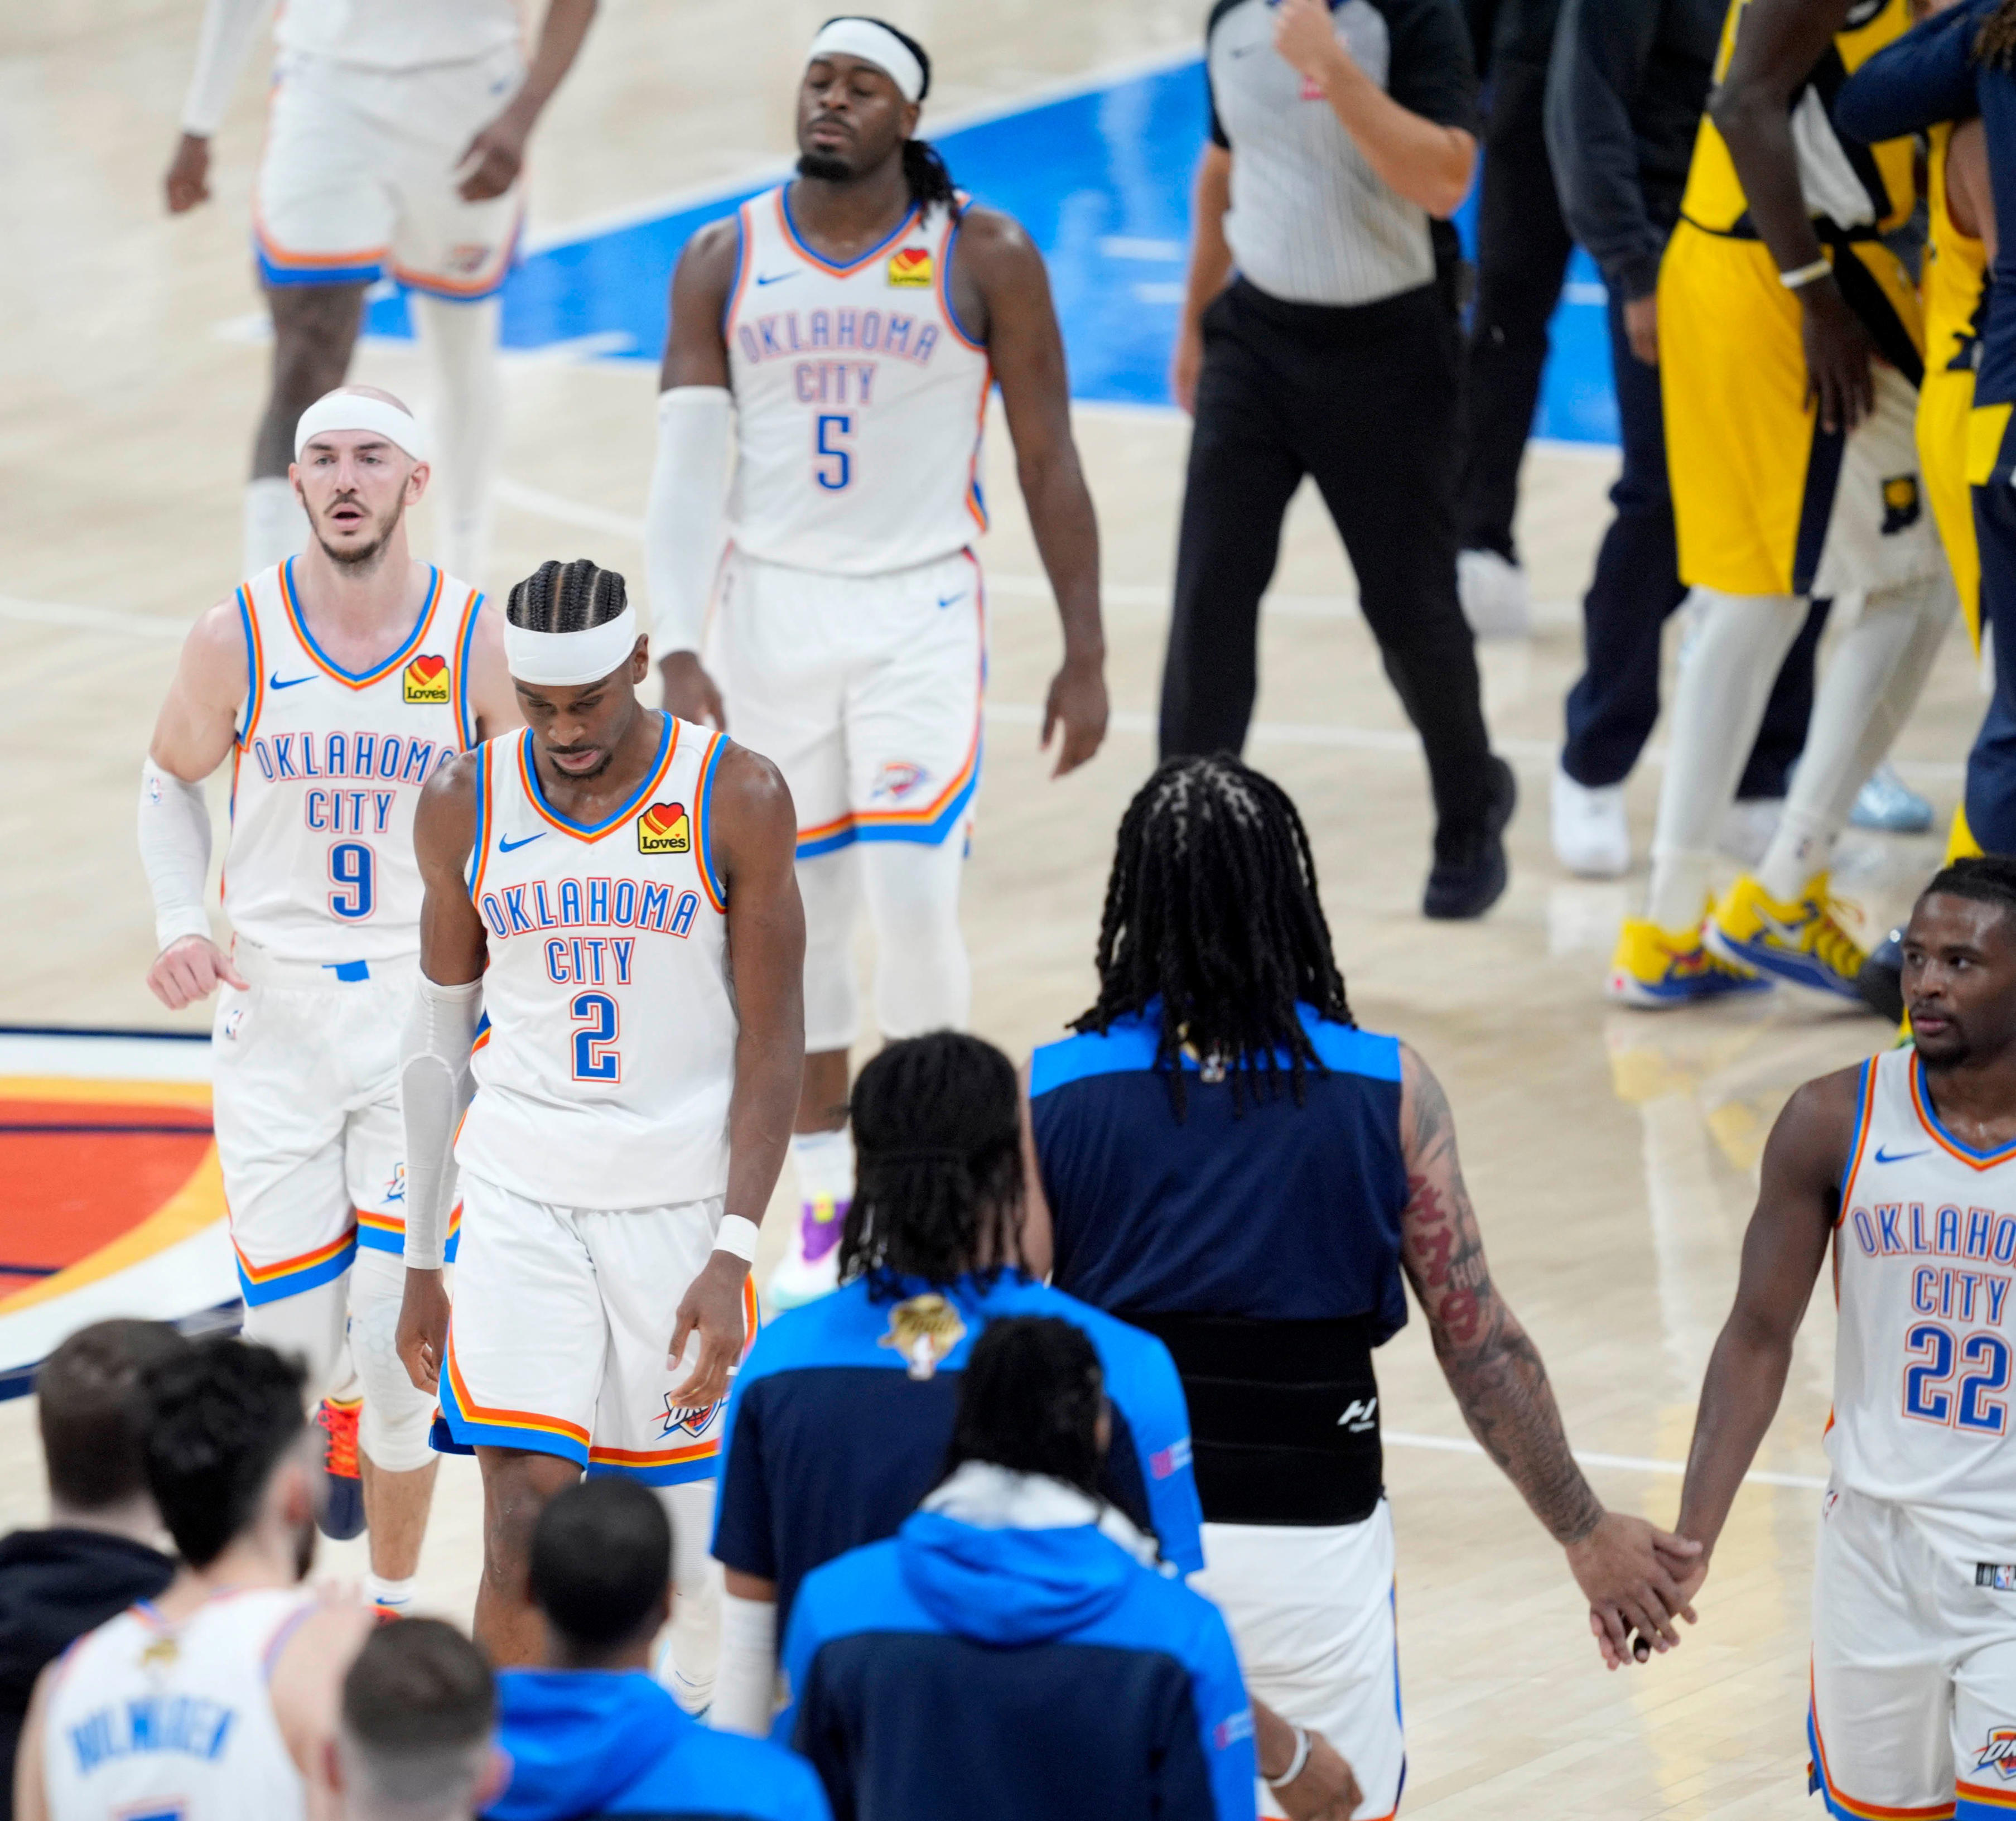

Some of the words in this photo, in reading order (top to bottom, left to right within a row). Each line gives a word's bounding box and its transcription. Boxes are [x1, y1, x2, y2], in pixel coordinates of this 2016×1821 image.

[737, 310, 941, 367] OKLAHOMA
[794, 360, 877, 405] CITY
[814, 411, 856, 492] 5
[305, 788, 396, 834] CITY
[328, 839, 376, 922] 9
[481, 877, 701, 940] OKLAHOMA
[544, 937, 635, 985] CITY
[570, 990, 620, 1083] 2
[1851, 1202, 2016, 1266] OKLAHO
[1912, 1265, 2011, 1326] CITY
[1902, 1321, 2012, 1436] 22
